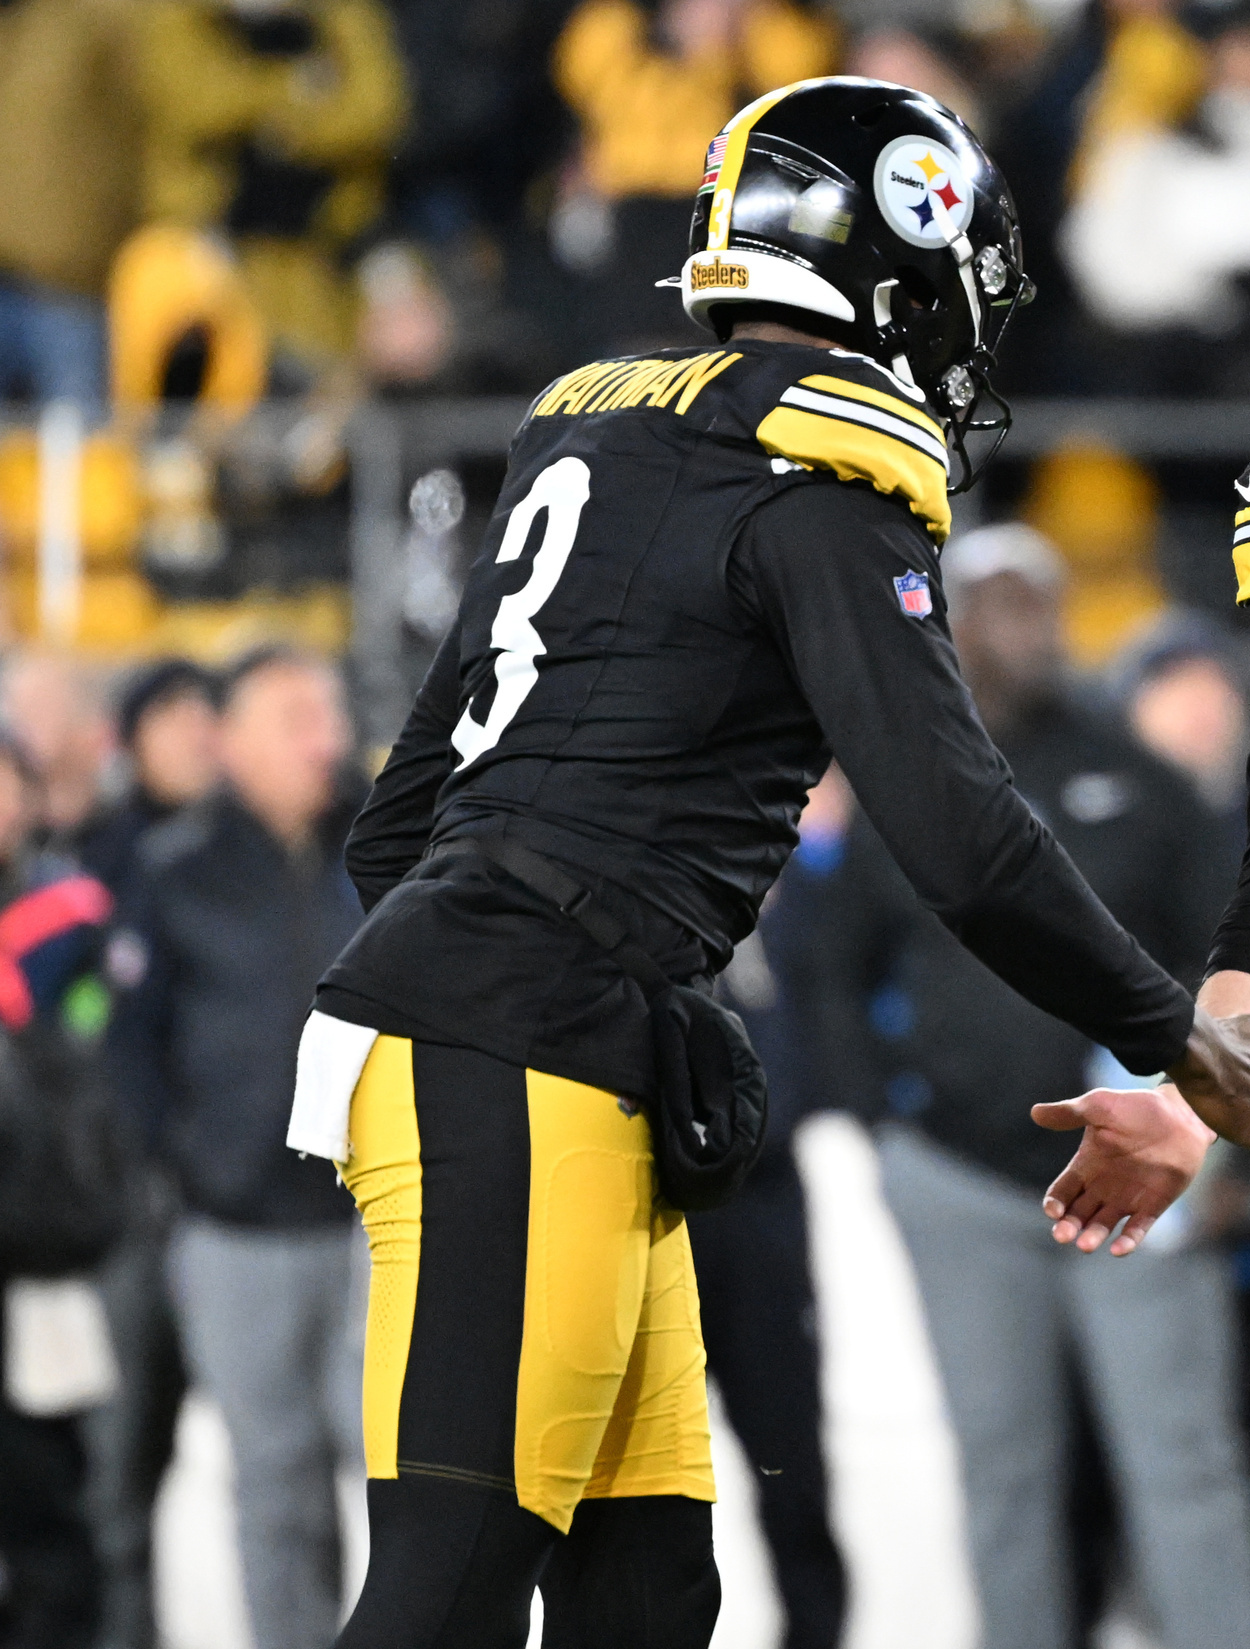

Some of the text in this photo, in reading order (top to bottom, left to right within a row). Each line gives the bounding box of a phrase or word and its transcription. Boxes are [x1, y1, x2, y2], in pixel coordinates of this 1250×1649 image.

[891, 170, 925, 190] Steelers
[707, 188, 733, 249] 3
[690, 255, 749, 292] Steelers
[451, 456, 591, 772] 3
